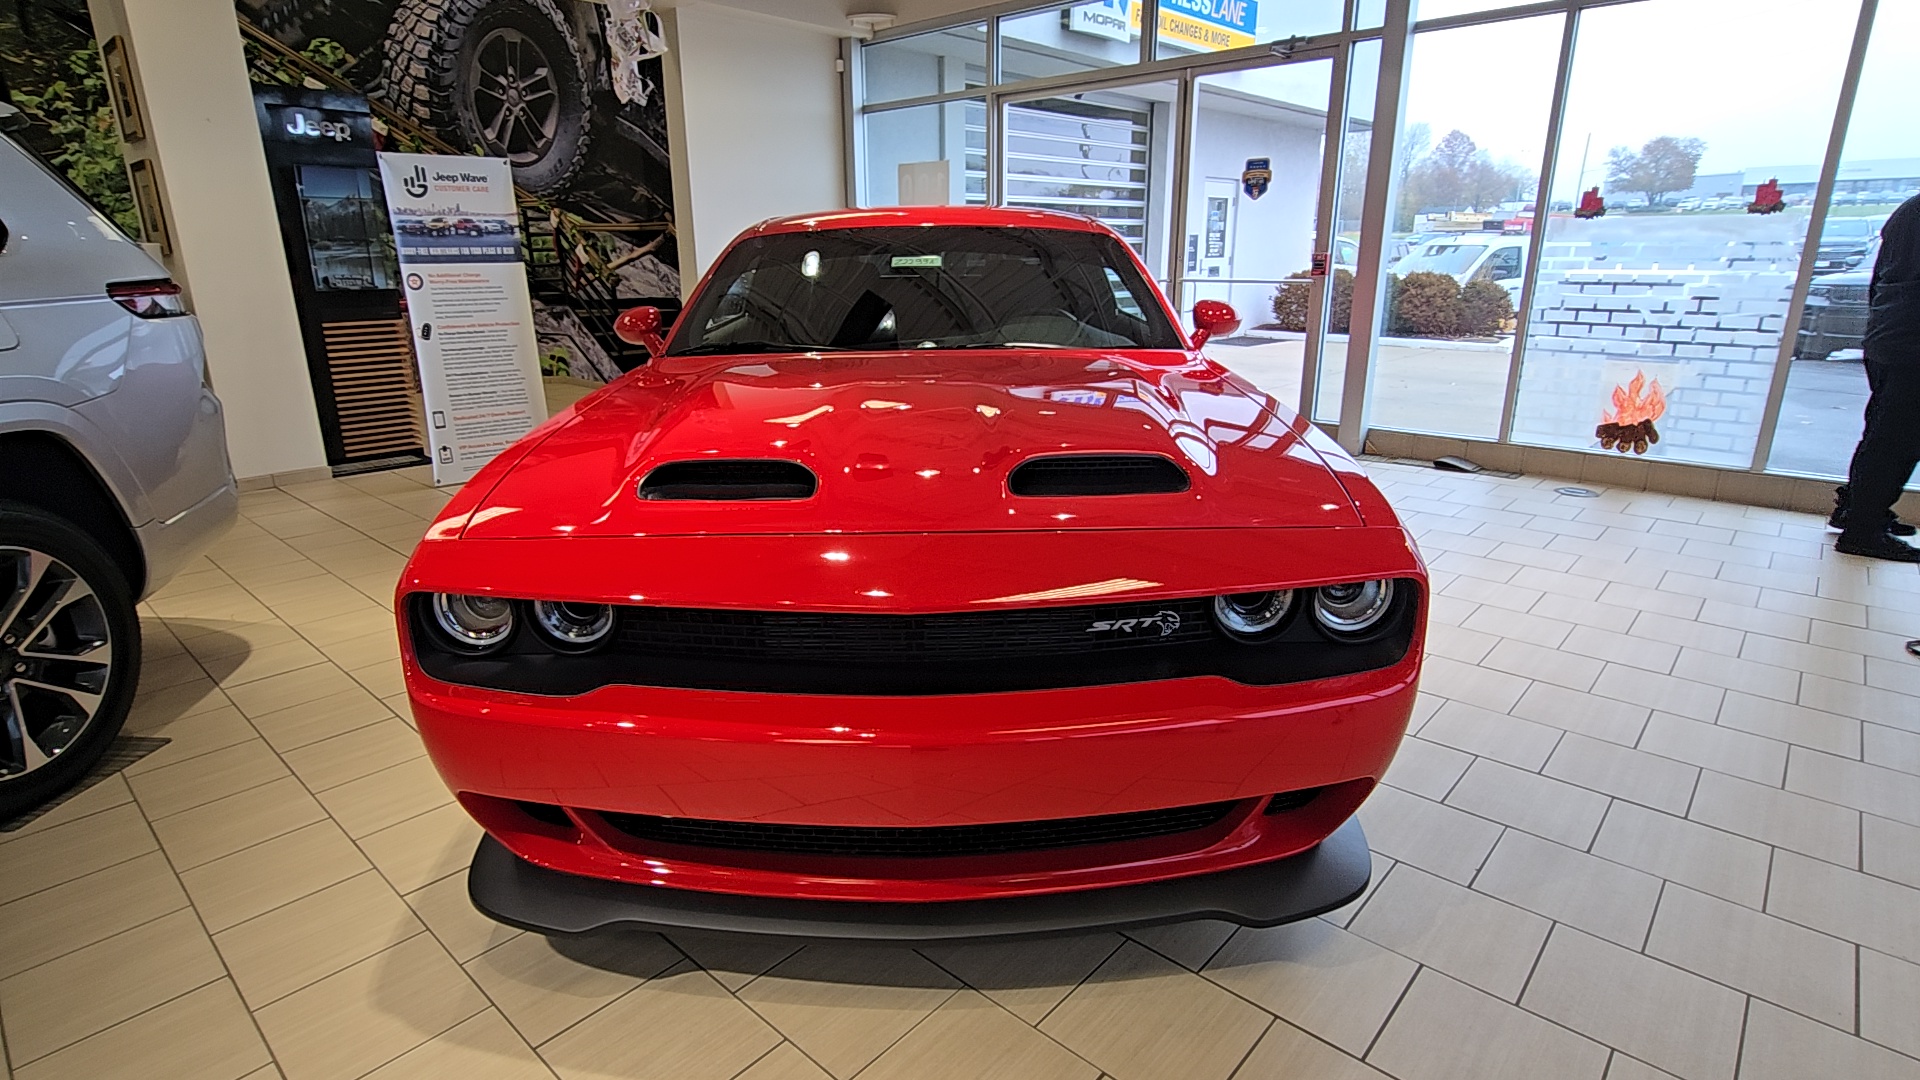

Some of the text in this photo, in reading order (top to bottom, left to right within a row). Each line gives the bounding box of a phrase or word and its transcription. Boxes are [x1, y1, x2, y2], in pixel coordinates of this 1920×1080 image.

[1083, 10, 1126, 32] MOPAR
[1169, 18, 1203, 39] CHANGES
[1203, 29, 1209, 42] &
[1211, 30, 1231, 47] MORE
[286, 113, 351, 142] Jeep
[432, 171, 488, 183] Jeep Wave
[434, 184, 490, 193] CUSTOMER CARE
[1085, 616, 1163, 633] SRT
